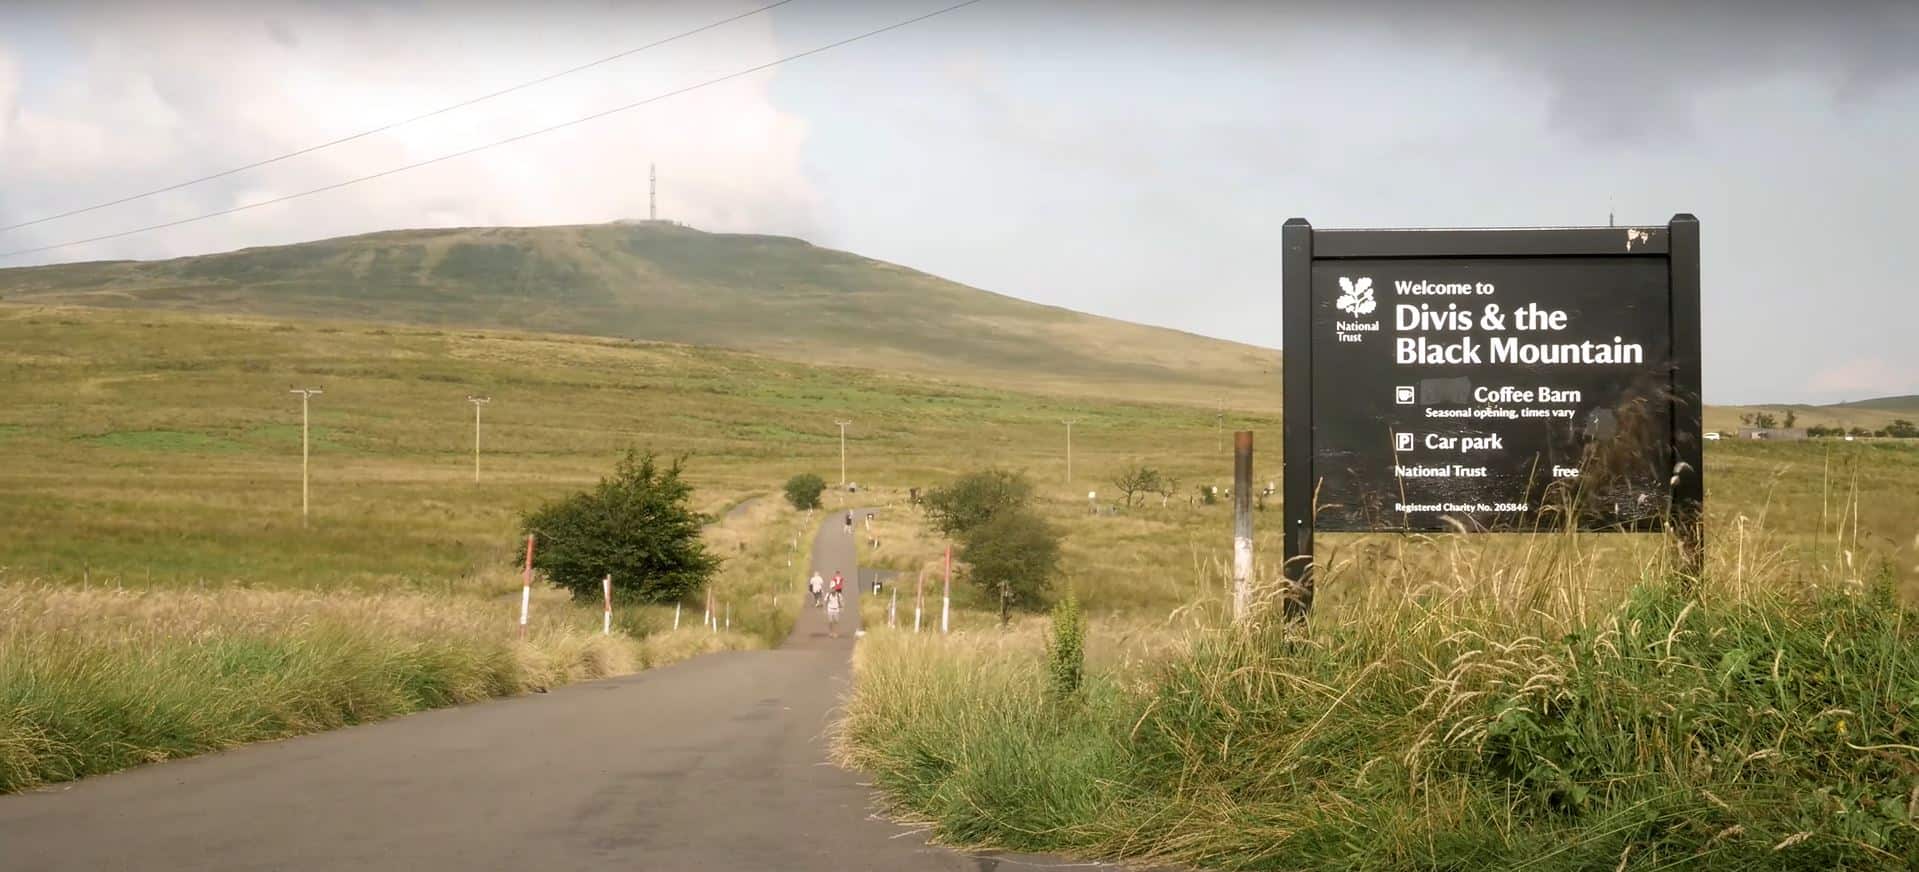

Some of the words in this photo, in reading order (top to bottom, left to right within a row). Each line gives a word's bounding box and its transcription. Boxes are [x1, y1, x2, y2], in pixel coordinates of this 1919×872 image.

[1395, 280, 1472, 295] Welcome
[1475, 282, 1495, 295] to
[1396, 303, 1473, 331] Divis
[1480, 303, 1506, 331] &
[1514, 303, 1568, 331] the
[1336, 321, 1379, 331] National
[1336, 332, 1362, 342] Trust
[1396, 336, 1482, 364] Black
[1490, 336, 1643, 364] Mountain
[1474, 386, 1534, 403] Coffee
[1538, 387, 1581, 403] Barn
[1425, 407, 1472, 418] Seasonal
[1473, 407, 1519, 419] opening,
[1521, 407, 1550, 418] times
[1552, 408, 1576, 419] vary
[1399, 435, 1410, 449] P
[1425, 433, 1458, 450] Car
[1461, 432, 1503, 453] park
[1395, 465, 1451, 478] National
[1452, 465, 1487, 478] Trust
[1552, 465, 1580, 478] free
[1395, 503, 1441, 514] Registered
[1443, 502, 1476, 513] Charity
[1477, 503, 1493, 513] No.
[1494, 503, 1528, 513] 205846
